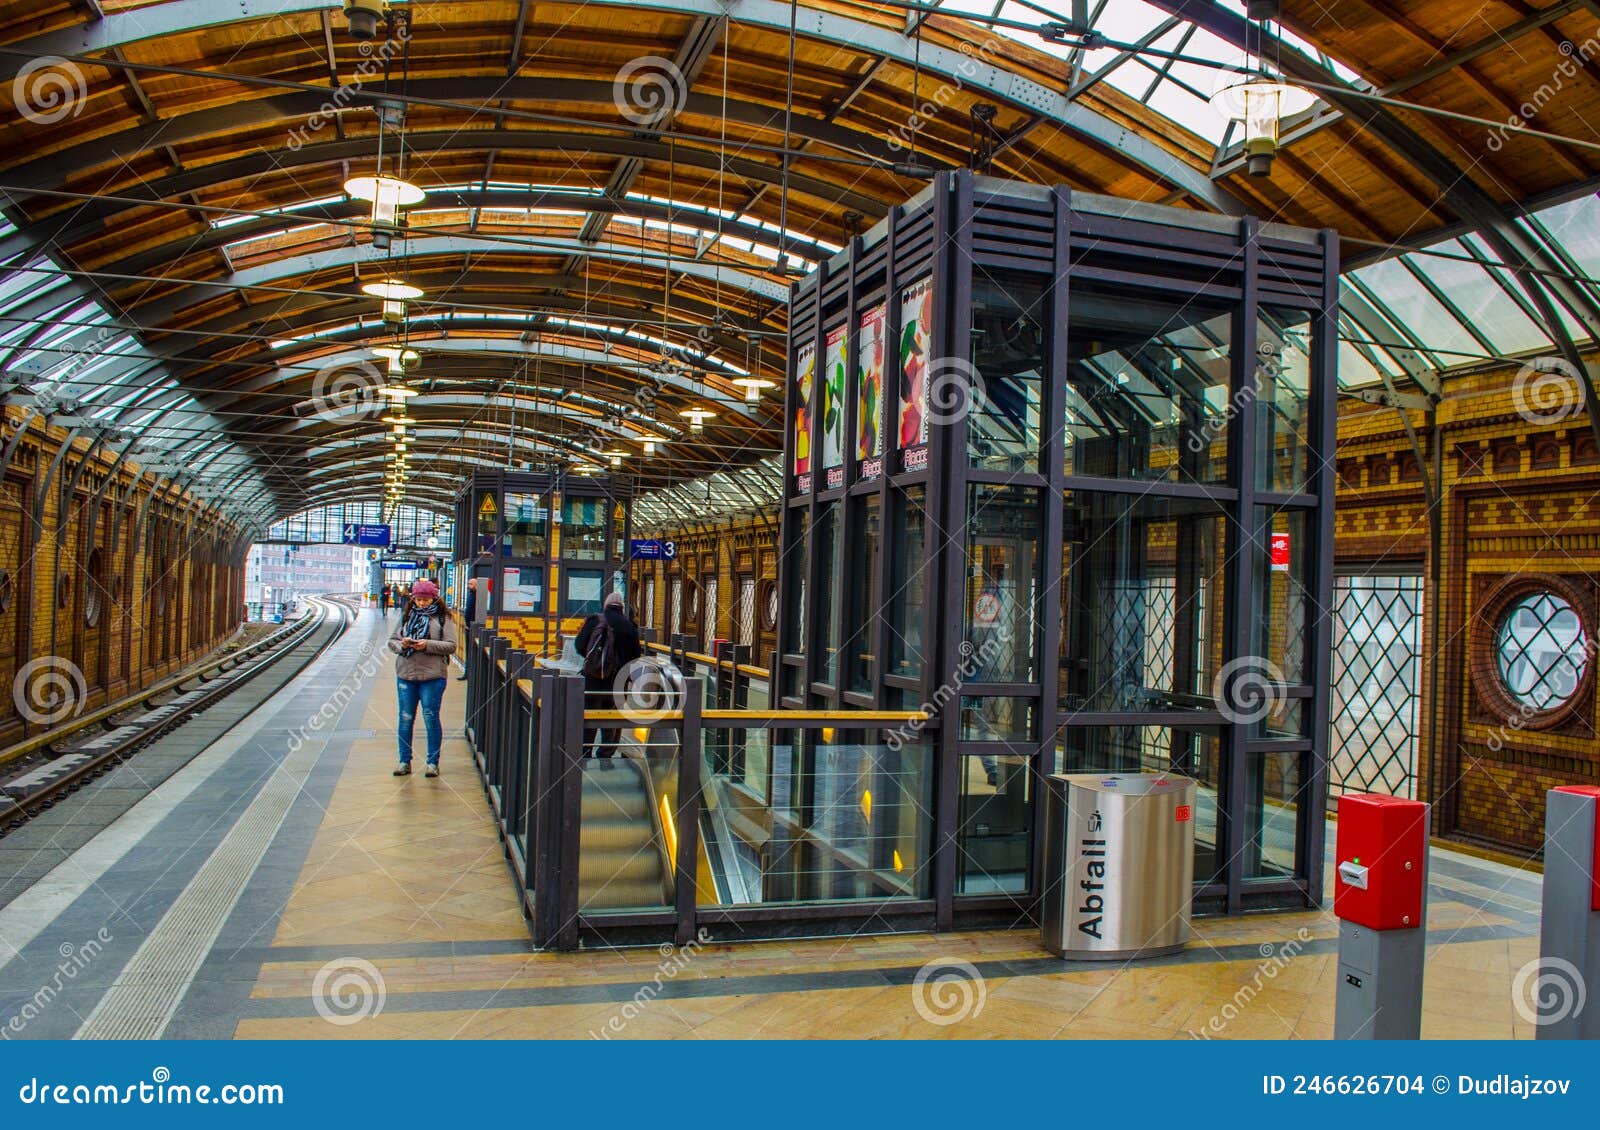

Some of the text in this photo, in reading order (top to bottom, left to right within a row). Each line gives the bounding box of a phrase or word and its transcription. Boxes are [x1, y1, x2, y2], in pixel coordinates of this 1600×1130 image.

[344, 524, 356, 540] 4
[665, 541, 675, 556] 3
[1078, 839, 1106, 940] Abfall
